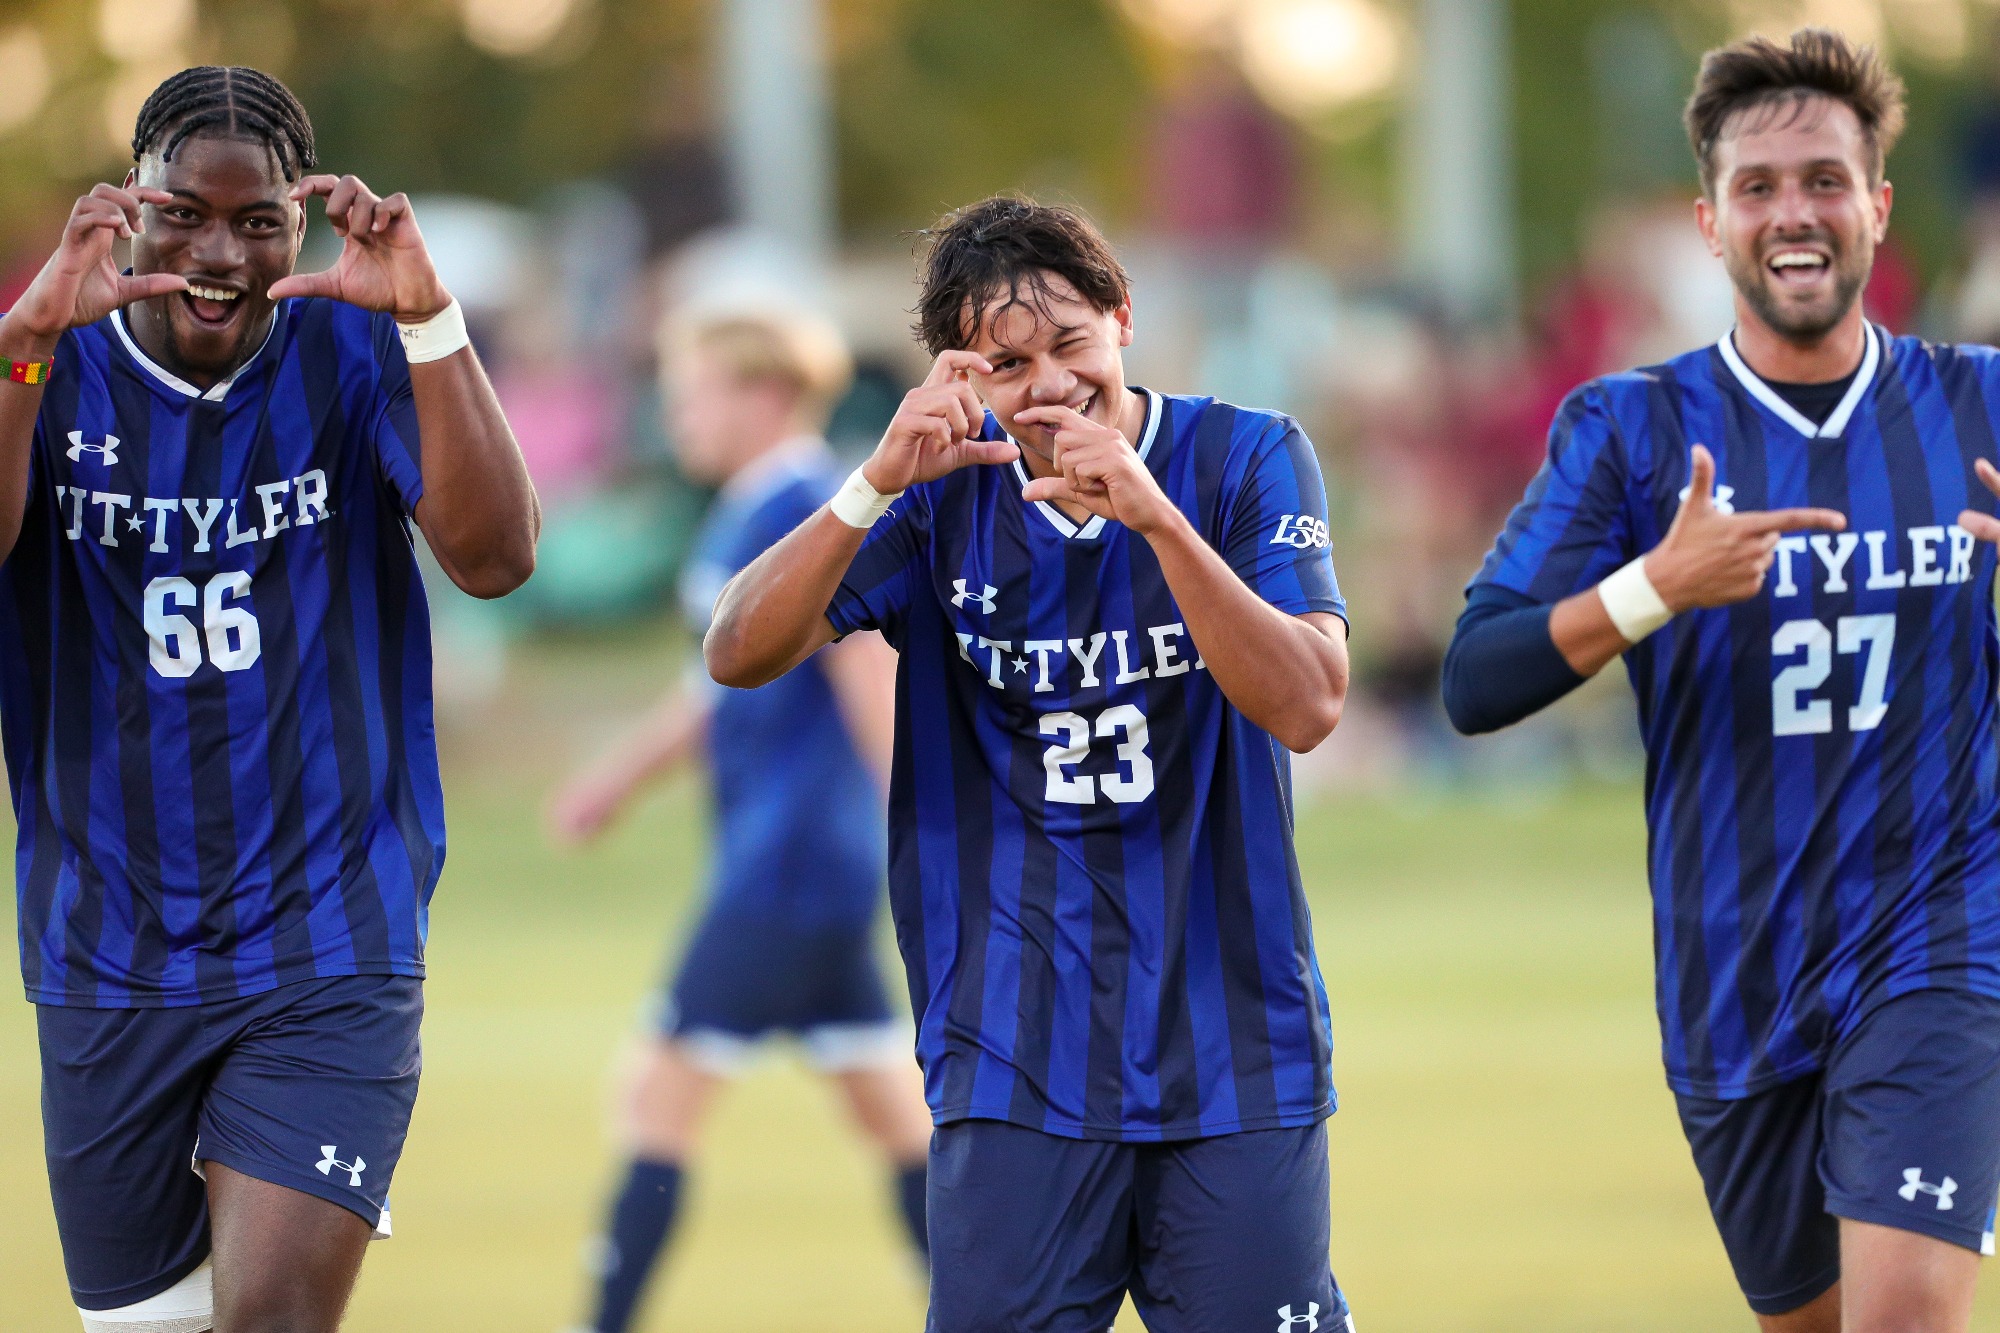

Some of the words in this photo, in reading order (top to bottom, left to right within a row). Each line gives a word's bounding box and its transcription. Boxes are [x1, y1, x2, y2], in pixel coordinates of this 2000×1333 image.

[144, 469, 330, 553] TYLER
[1774, 525, 1976, 598] TYLER
[144, 570, 261, 678] 66
[1024, 622, 1206, 692] TYLE
[1771, 613, 1897, 737] 27
[1038, 703, 1155, 804] 23
